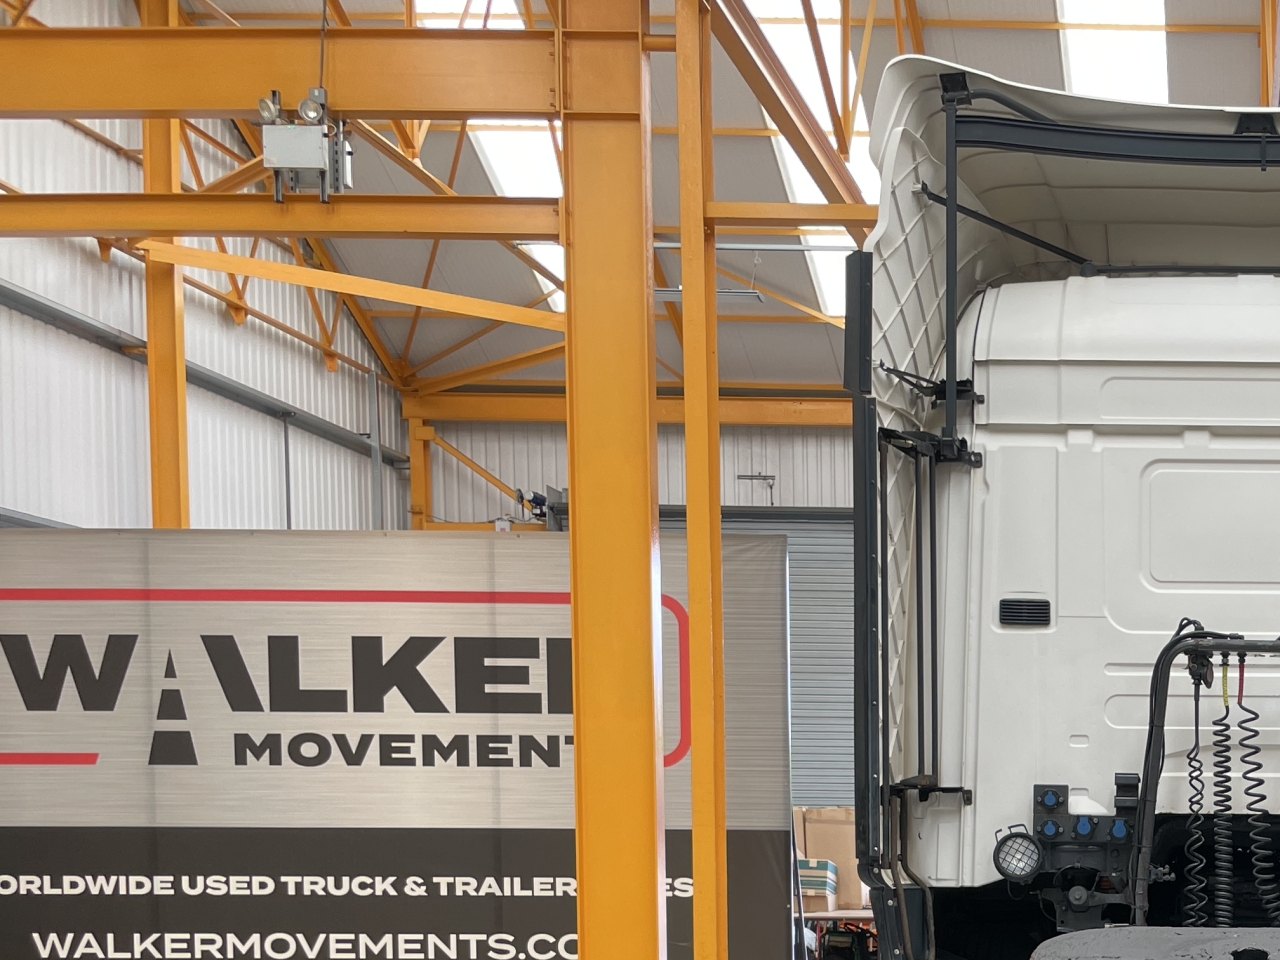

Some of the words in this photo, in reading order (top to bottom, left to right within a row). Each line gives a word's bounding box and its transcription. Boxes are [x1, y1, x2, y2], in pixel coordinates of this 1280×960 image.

[0, 634, 573, 765] WALKE
[233, 731, 575, 768] MOVEMEN
[0, 875, 174, 894] ORLDWIDE
[182, 876, 275, 895] USED
[281, 876, 397, 895] TRUCK
[404, 877, 426, 896] &
[433, 876, 577, 897] TRAILER
[32, 932, 579, 960] WALKERMOVEMENTS.CO
